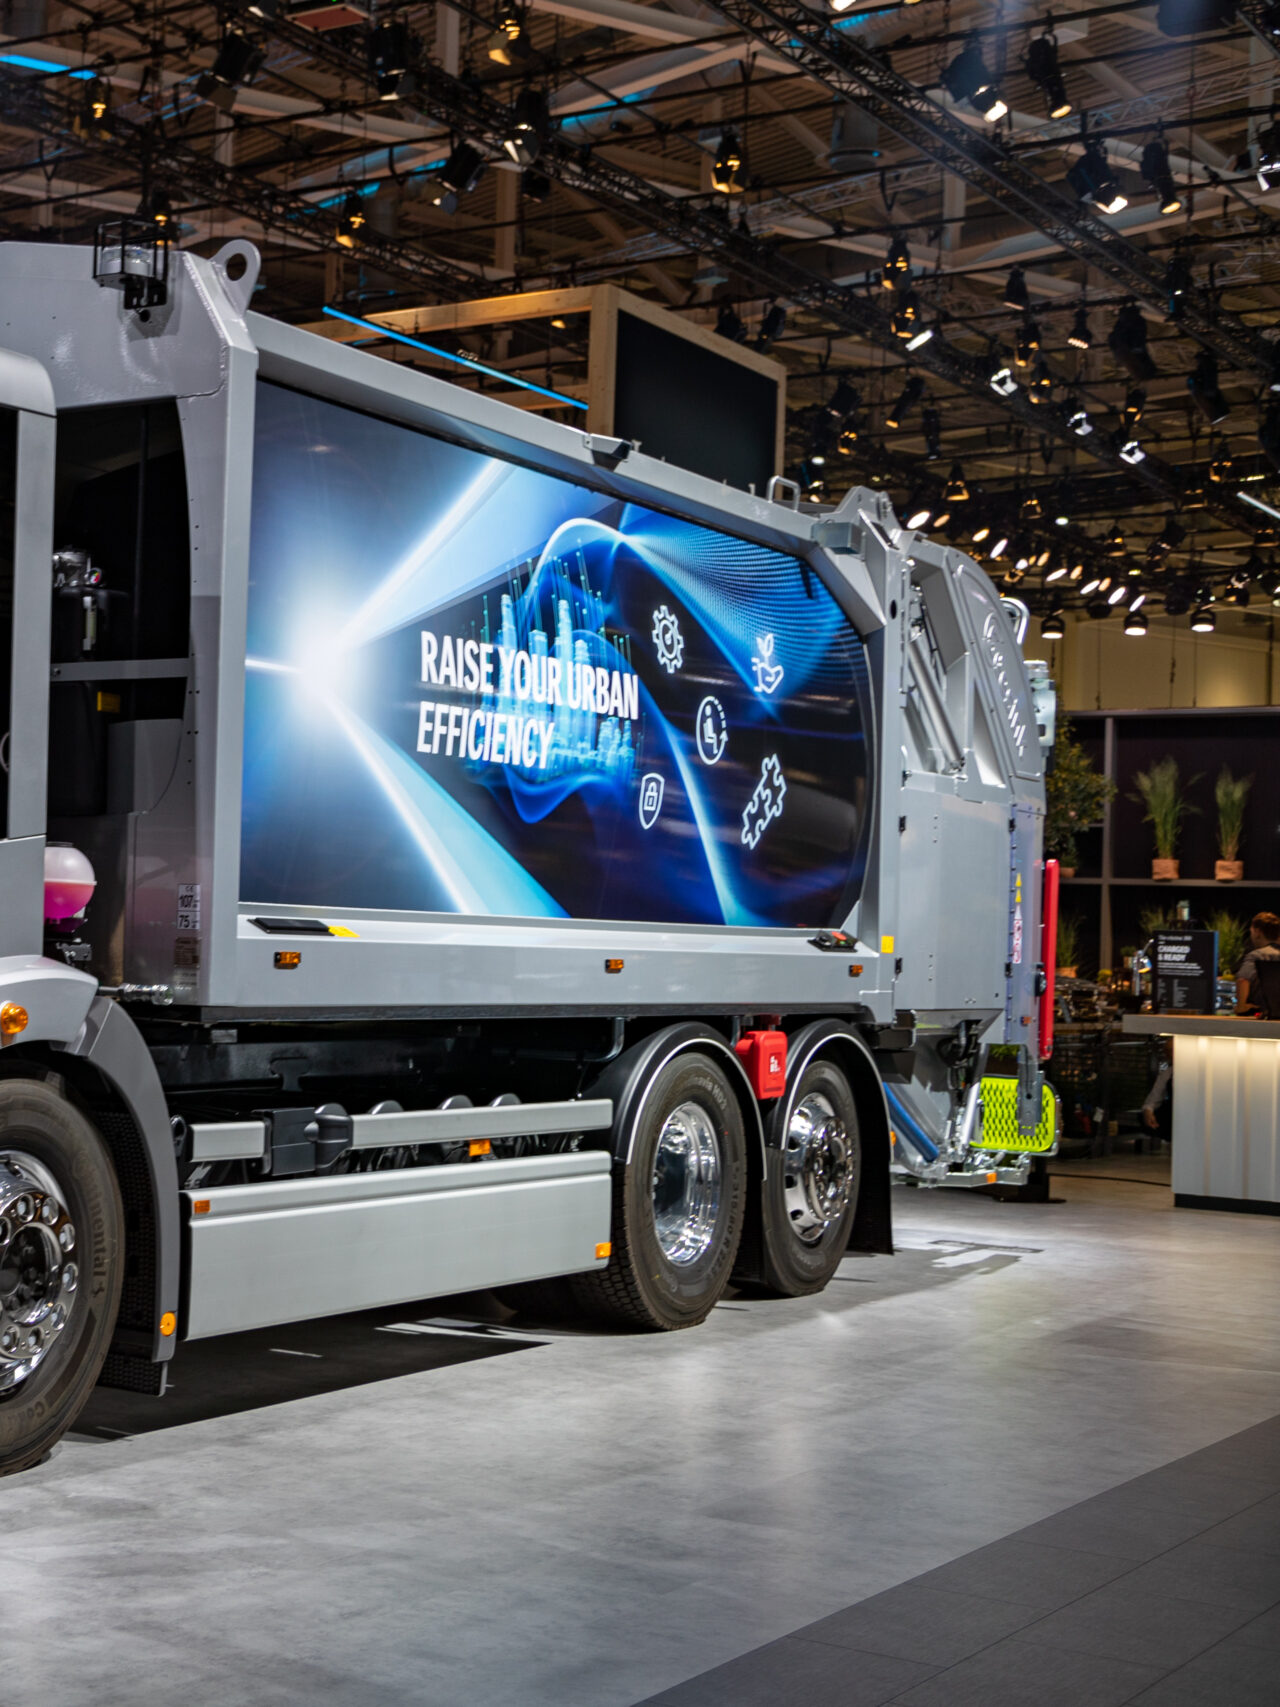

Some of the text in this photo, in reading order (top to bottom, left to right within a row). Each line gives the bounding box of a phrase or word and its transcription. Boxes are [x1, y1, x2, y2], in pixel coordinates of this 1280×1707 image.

[420, 630, 639, 720] RAISE YOUR URBAN
[417, 701, 555, 769] EFFICIENCY
[178, 914, 190, 928] 75
[1163, 953, 1187, 961] READY
